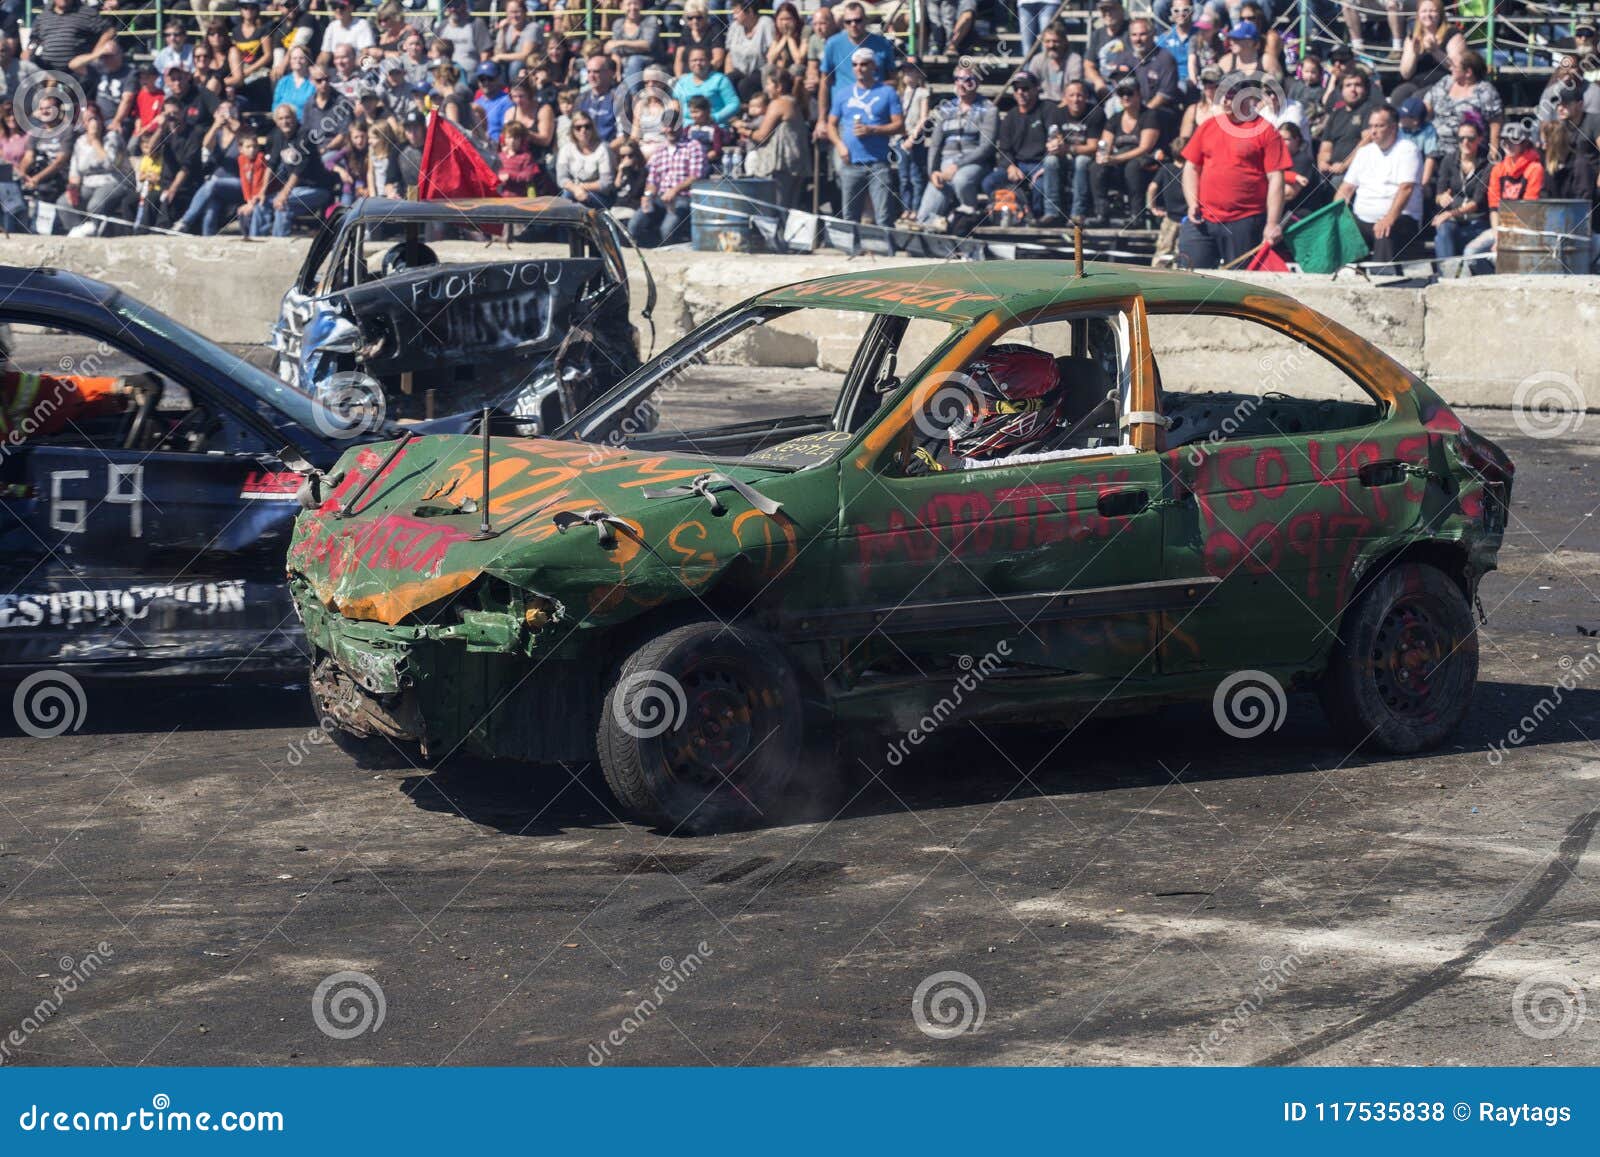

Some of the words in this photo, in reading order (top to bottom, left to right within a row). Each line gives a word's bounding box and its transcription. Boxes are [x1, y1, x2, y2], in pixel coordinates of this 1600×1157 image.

[503, 261, 563, 289] YOU
[50, 464, 144, 537] 69
[1201, 511, 1373, 612] 0097
